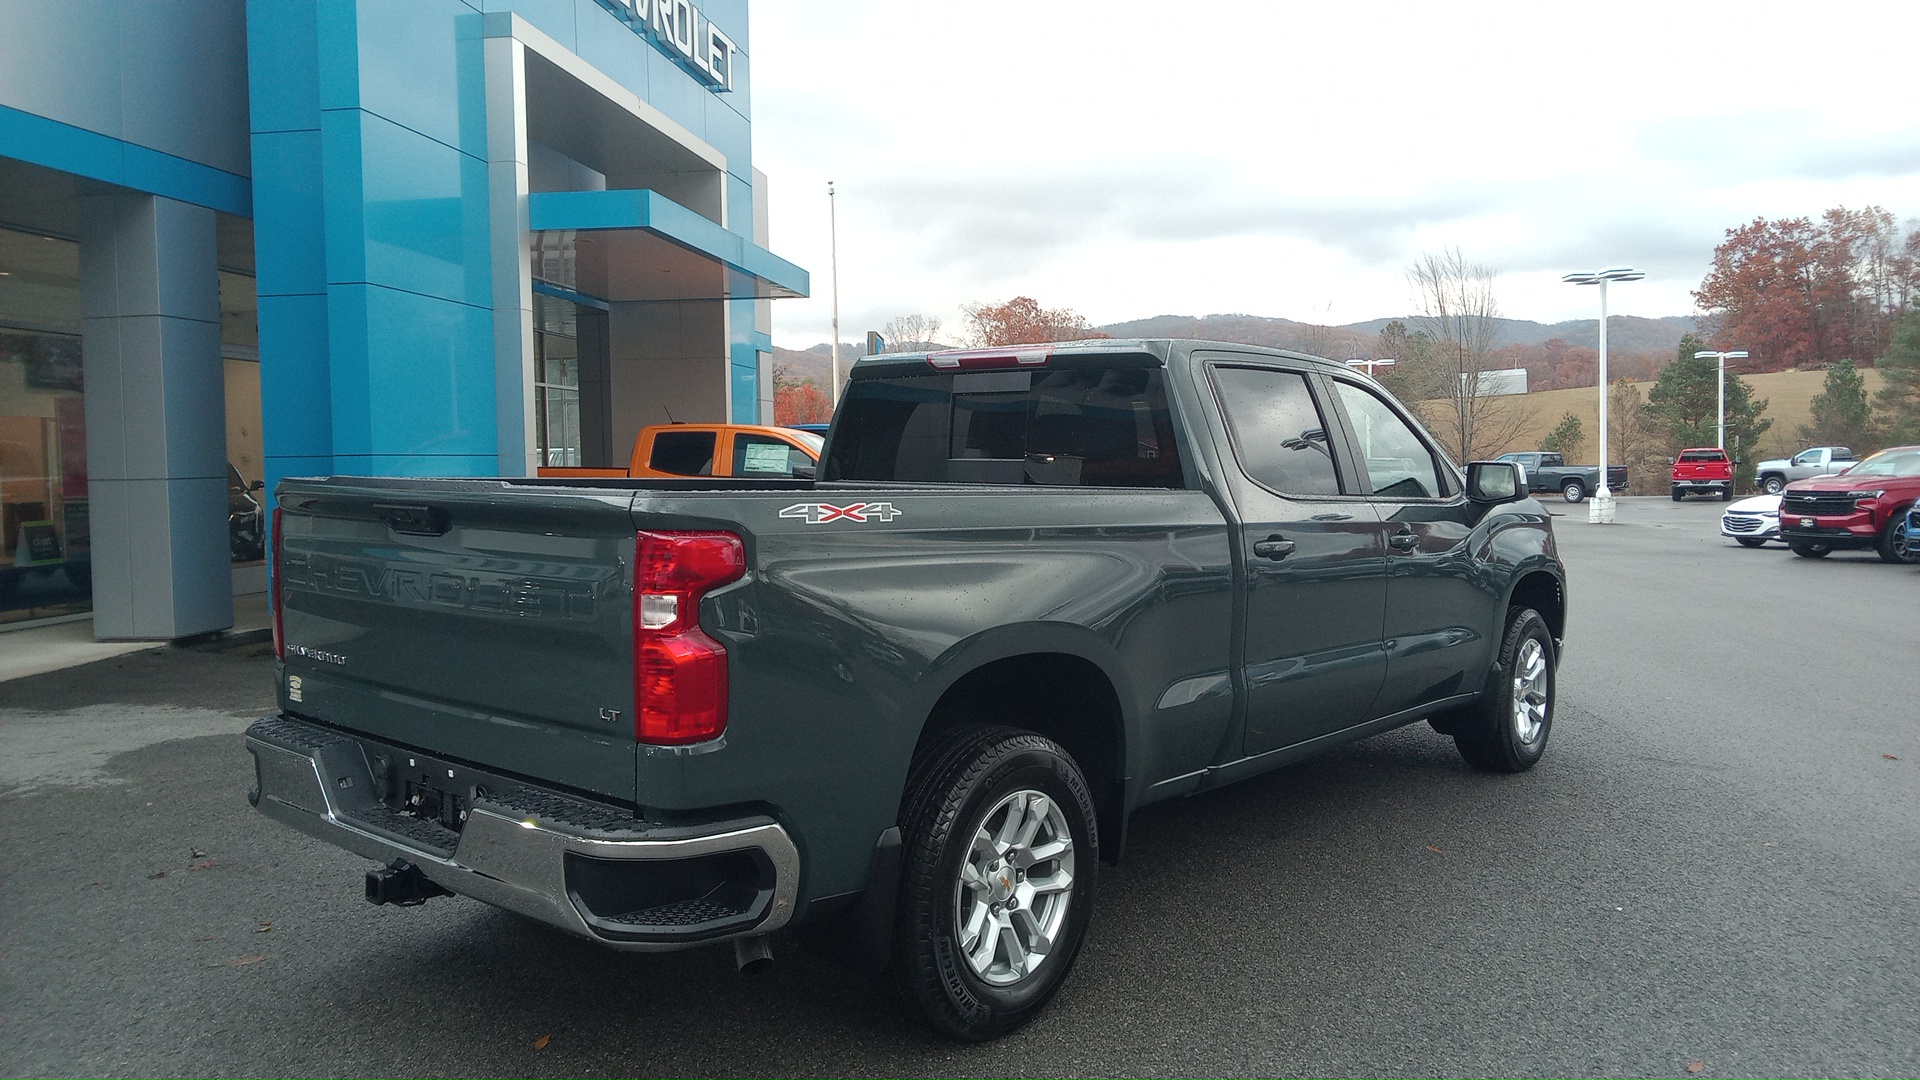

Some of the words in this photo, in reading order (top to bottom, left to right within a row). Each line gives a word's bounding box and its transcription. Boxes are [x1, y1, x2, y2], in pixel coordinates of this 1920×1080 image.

[285, 556, 597, 621] CHEVROLET
[598, 707, 621, 722] LT
[1069, 776, 1098, 845] MICHELIN
[939, 941, 977, 1012] MICHELIN
